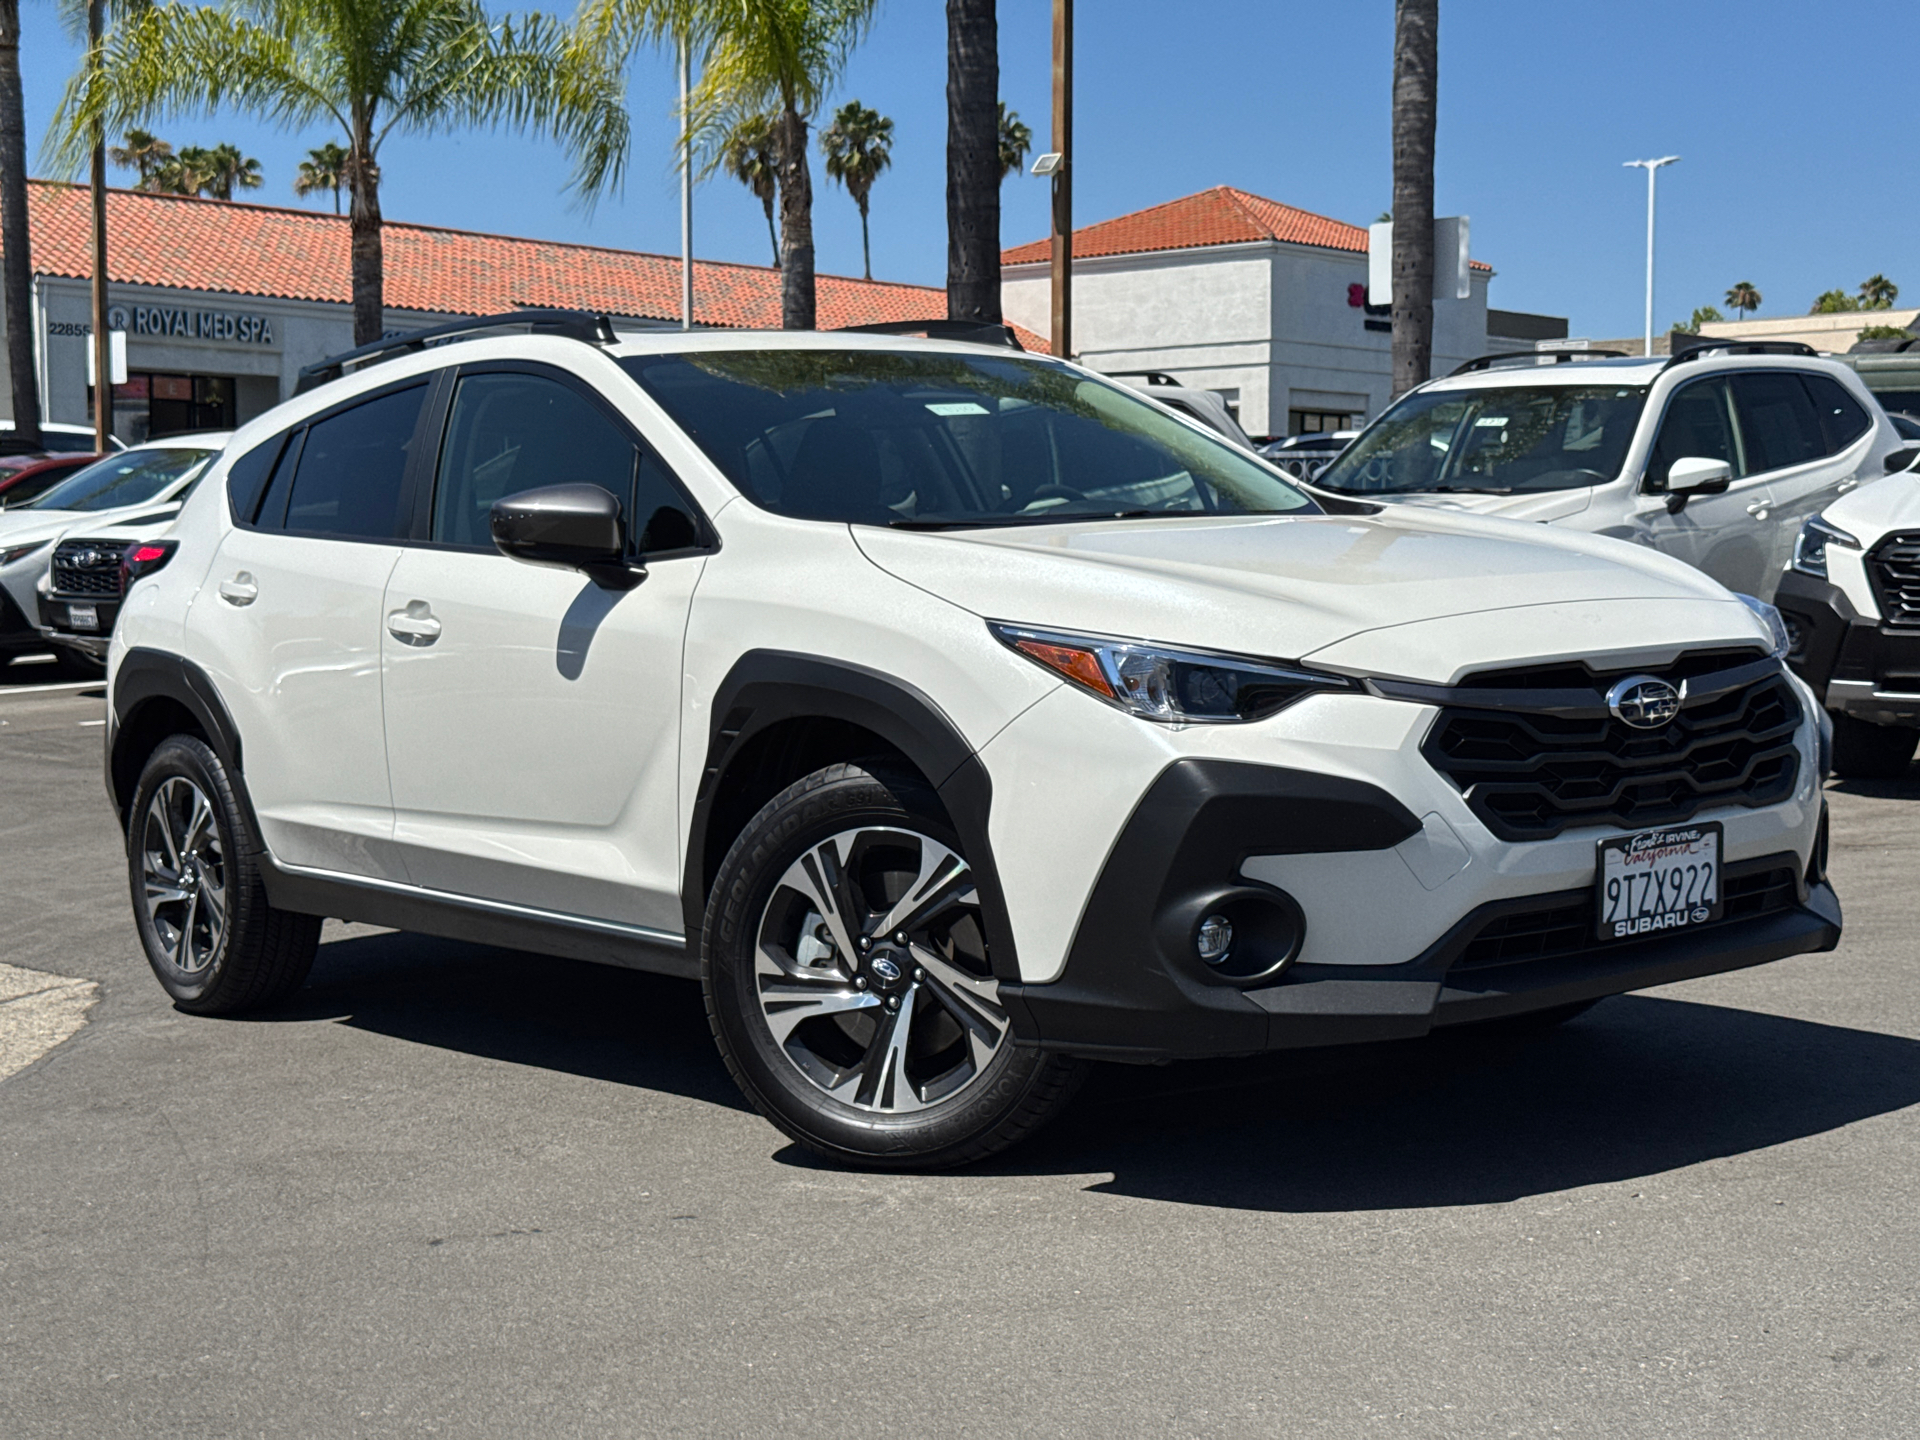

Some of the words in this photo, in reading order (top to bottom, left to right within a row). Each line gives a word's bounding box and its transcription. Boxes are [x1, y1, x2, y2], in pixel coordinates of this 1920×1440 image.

[49, 322, 91, 337] 22855
[134, 307, 195, 337] ROYAL
[198, 312, 235, 340] MED
[237, 315, 273, 344] SPA
[1624, 843, 1699, 868] California
[1607, 862, 1713, 923] 9TZX922
[1614, 909, 1689, 938] SUBARU
